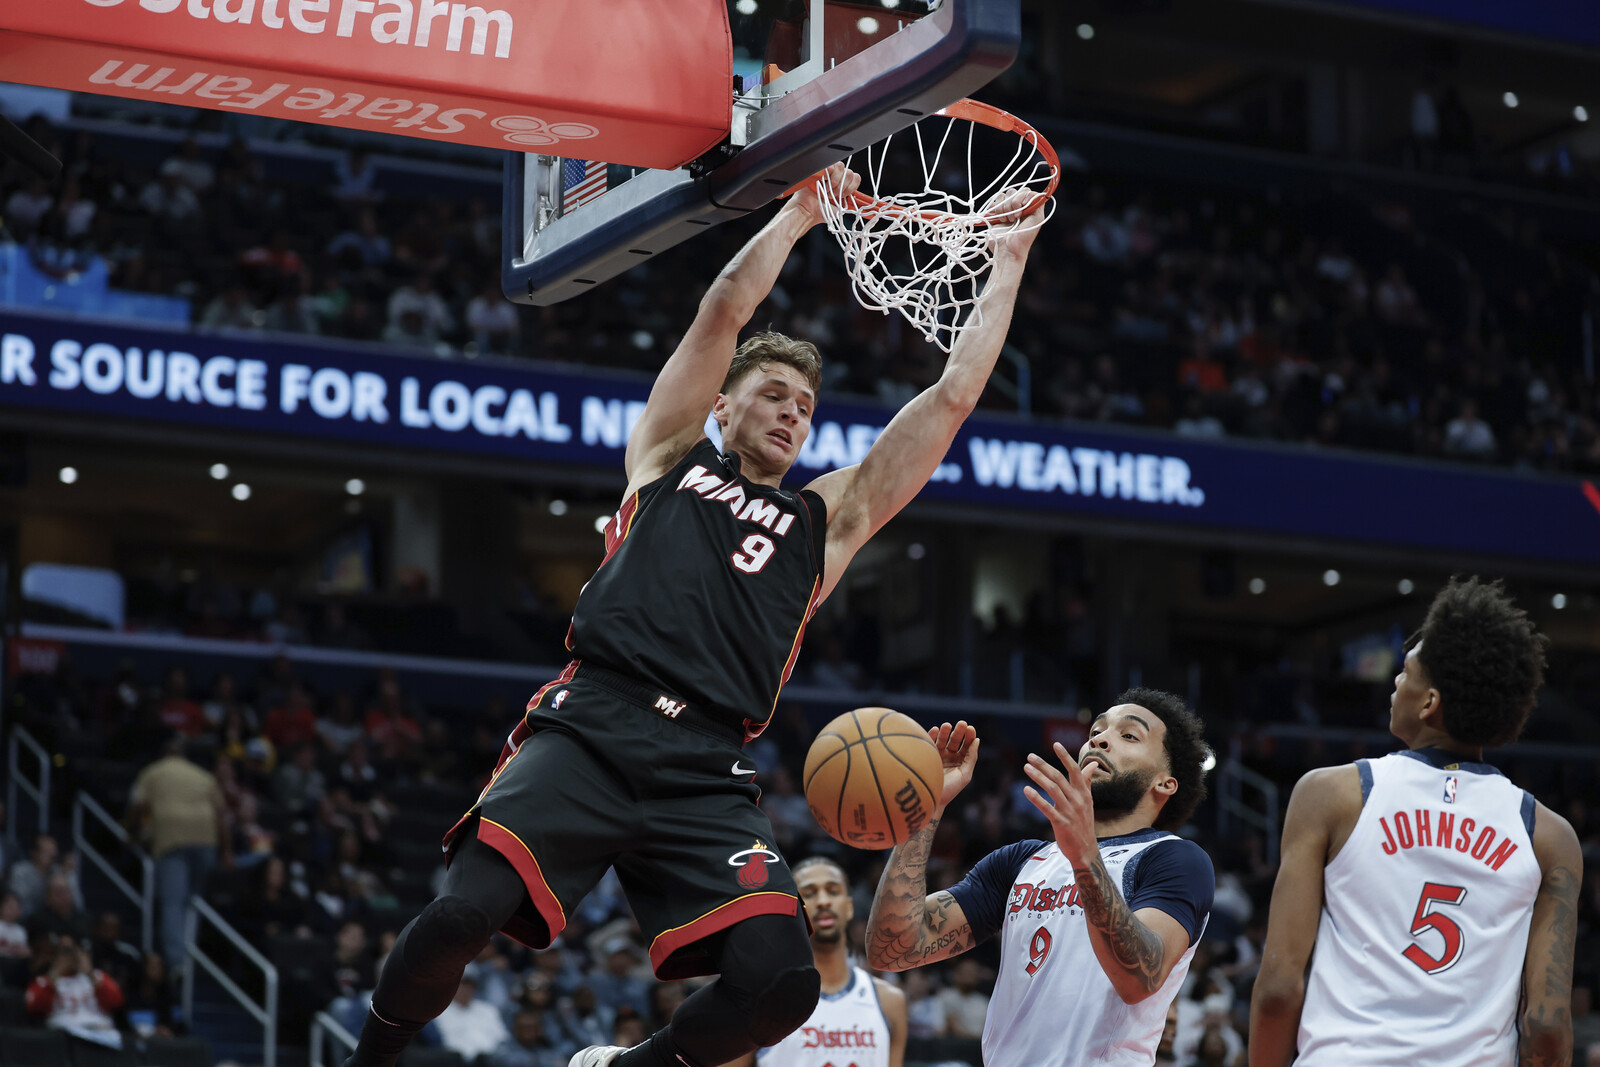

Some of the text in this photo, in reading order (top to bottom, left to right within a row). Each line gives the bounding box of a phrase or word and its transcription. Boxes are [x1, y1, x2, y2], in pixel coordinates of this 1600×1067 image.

[49, 339, 268, 411] SOURCE
[280, 363, 390, 424] FOR
[400, 376, 572, 443] LOCAL
[968, 436, 1205, 507] WEATHER.
[675, 464, 797, 538] MIAMI
[730, 533, 777, 574] 9
[1379, 809, 1519, 872] JOHNSON
[1025, 926, 1054, 977] 9
[1402, 881, 1468, 975] 5
[801, 1024, 877, 1049] District
